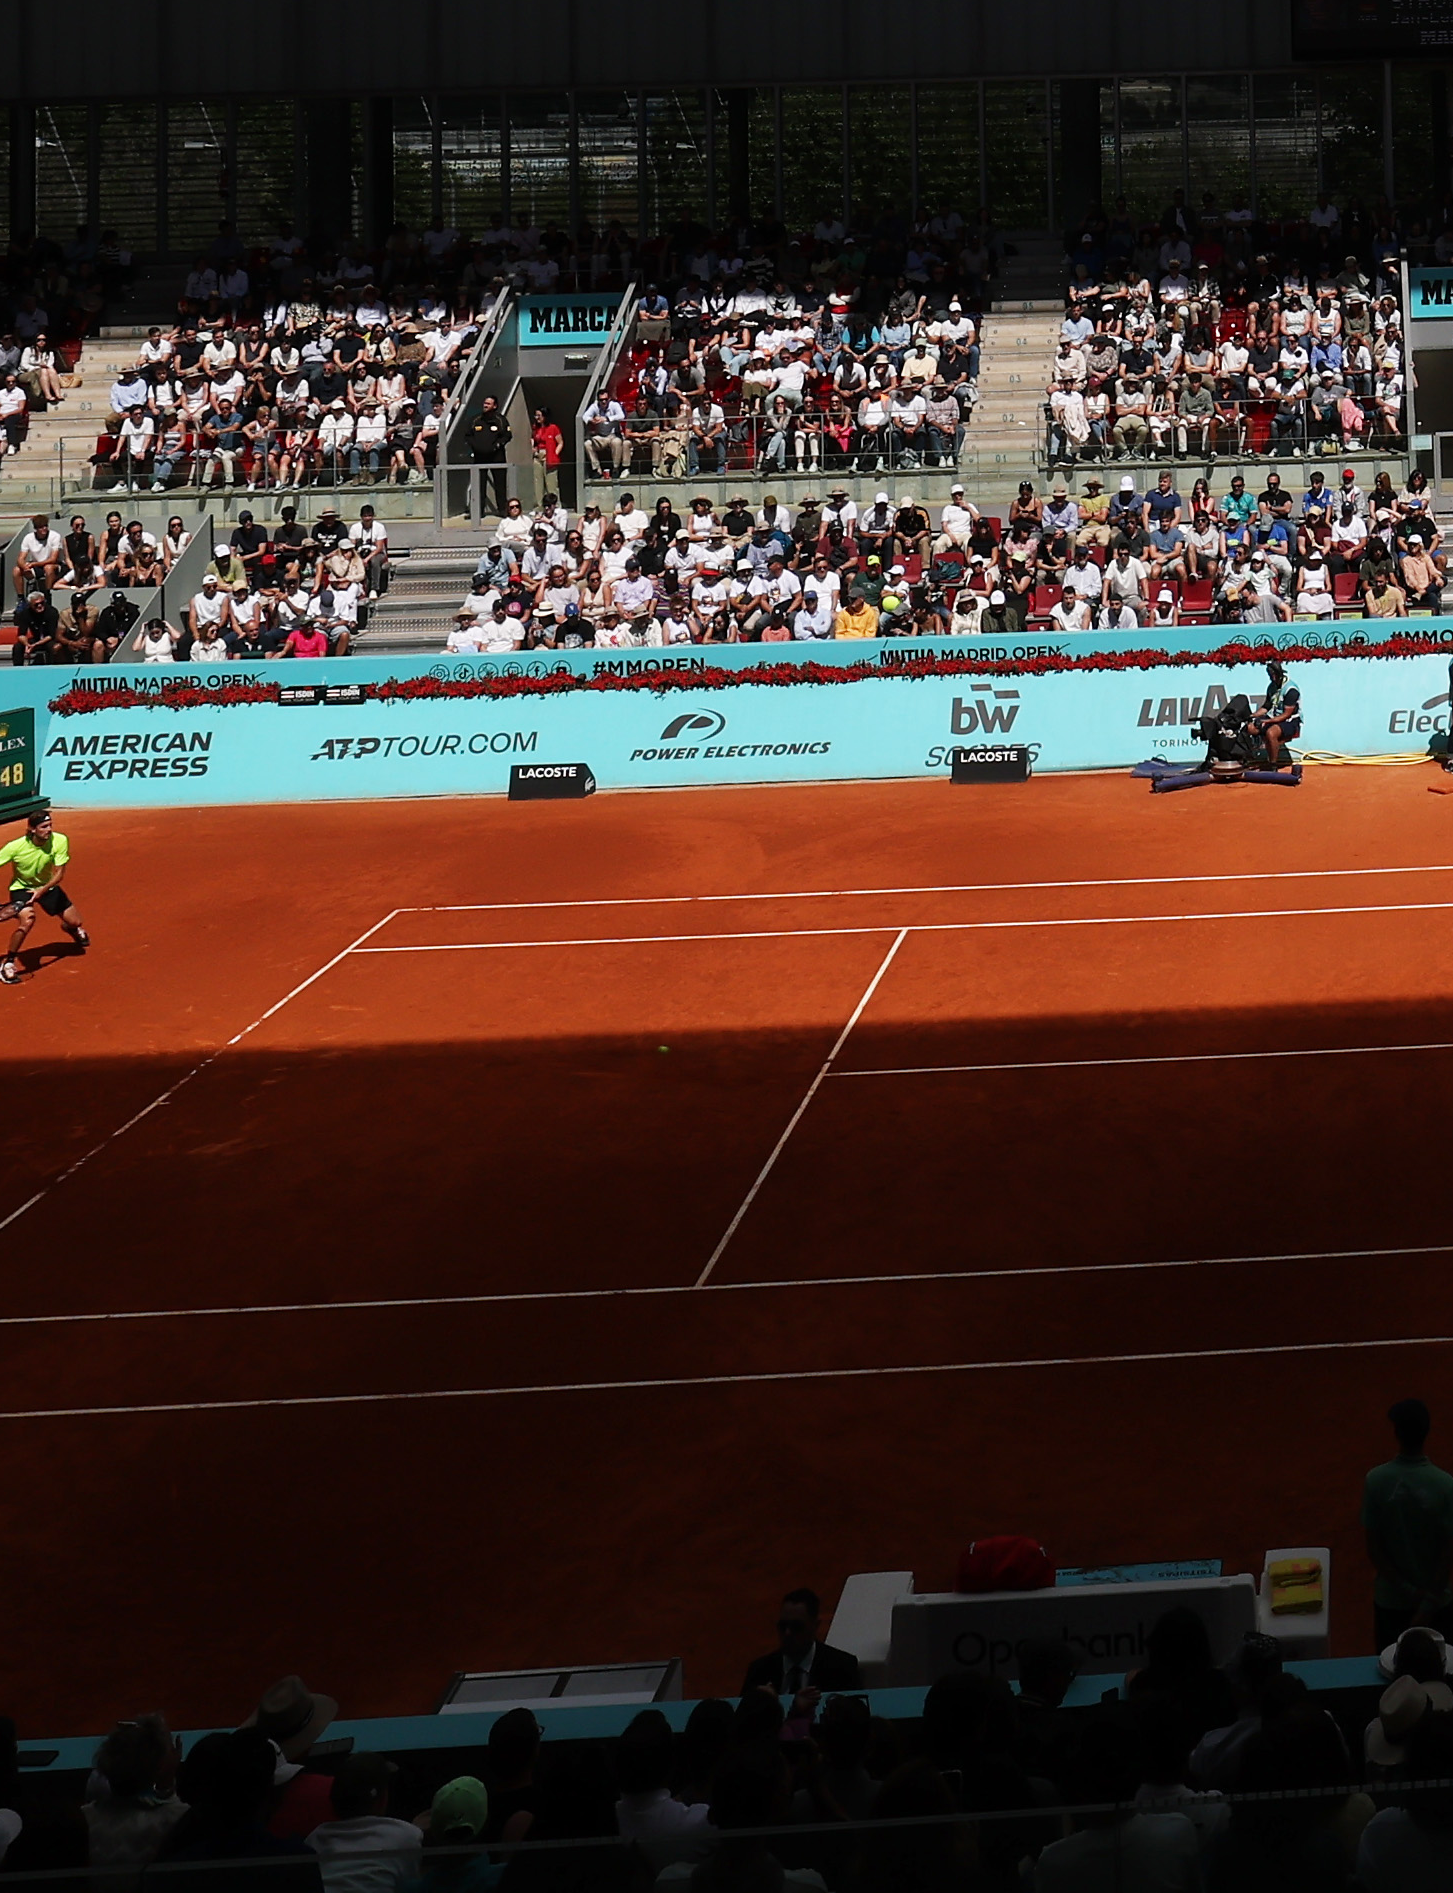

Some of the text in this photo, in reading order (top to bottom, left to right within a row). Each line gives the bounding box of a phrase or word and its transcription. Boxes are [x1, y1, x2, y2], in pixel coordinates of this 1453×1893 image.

[529, 306, 624, 334] MARCA
[1002, 413, 1015, 423] 02
[995, 454, 1008, 463] 01
[25, 485, 37, 494] 01
[880, 645, 1060, 665] MUTUA MADRID OPEN
[593, 657, 705, 677] #MMOPEN
[71, 676, 129, 692] MUTUA
[207, 673, 256, 689] OPEN
[949, 697, 1021, 735] bw
[45, 731, 213, 757] AMERICAN
[309, 731, 538, 761] ATPTOUR.COM
[629, 741, 832, 762] POWER ELECTRONICS
[960, 750, 1018, 763] LACOSTE
[64, 756, 211, 782] EXPRESS
[518, 765, 577, 779] LACOSTE
